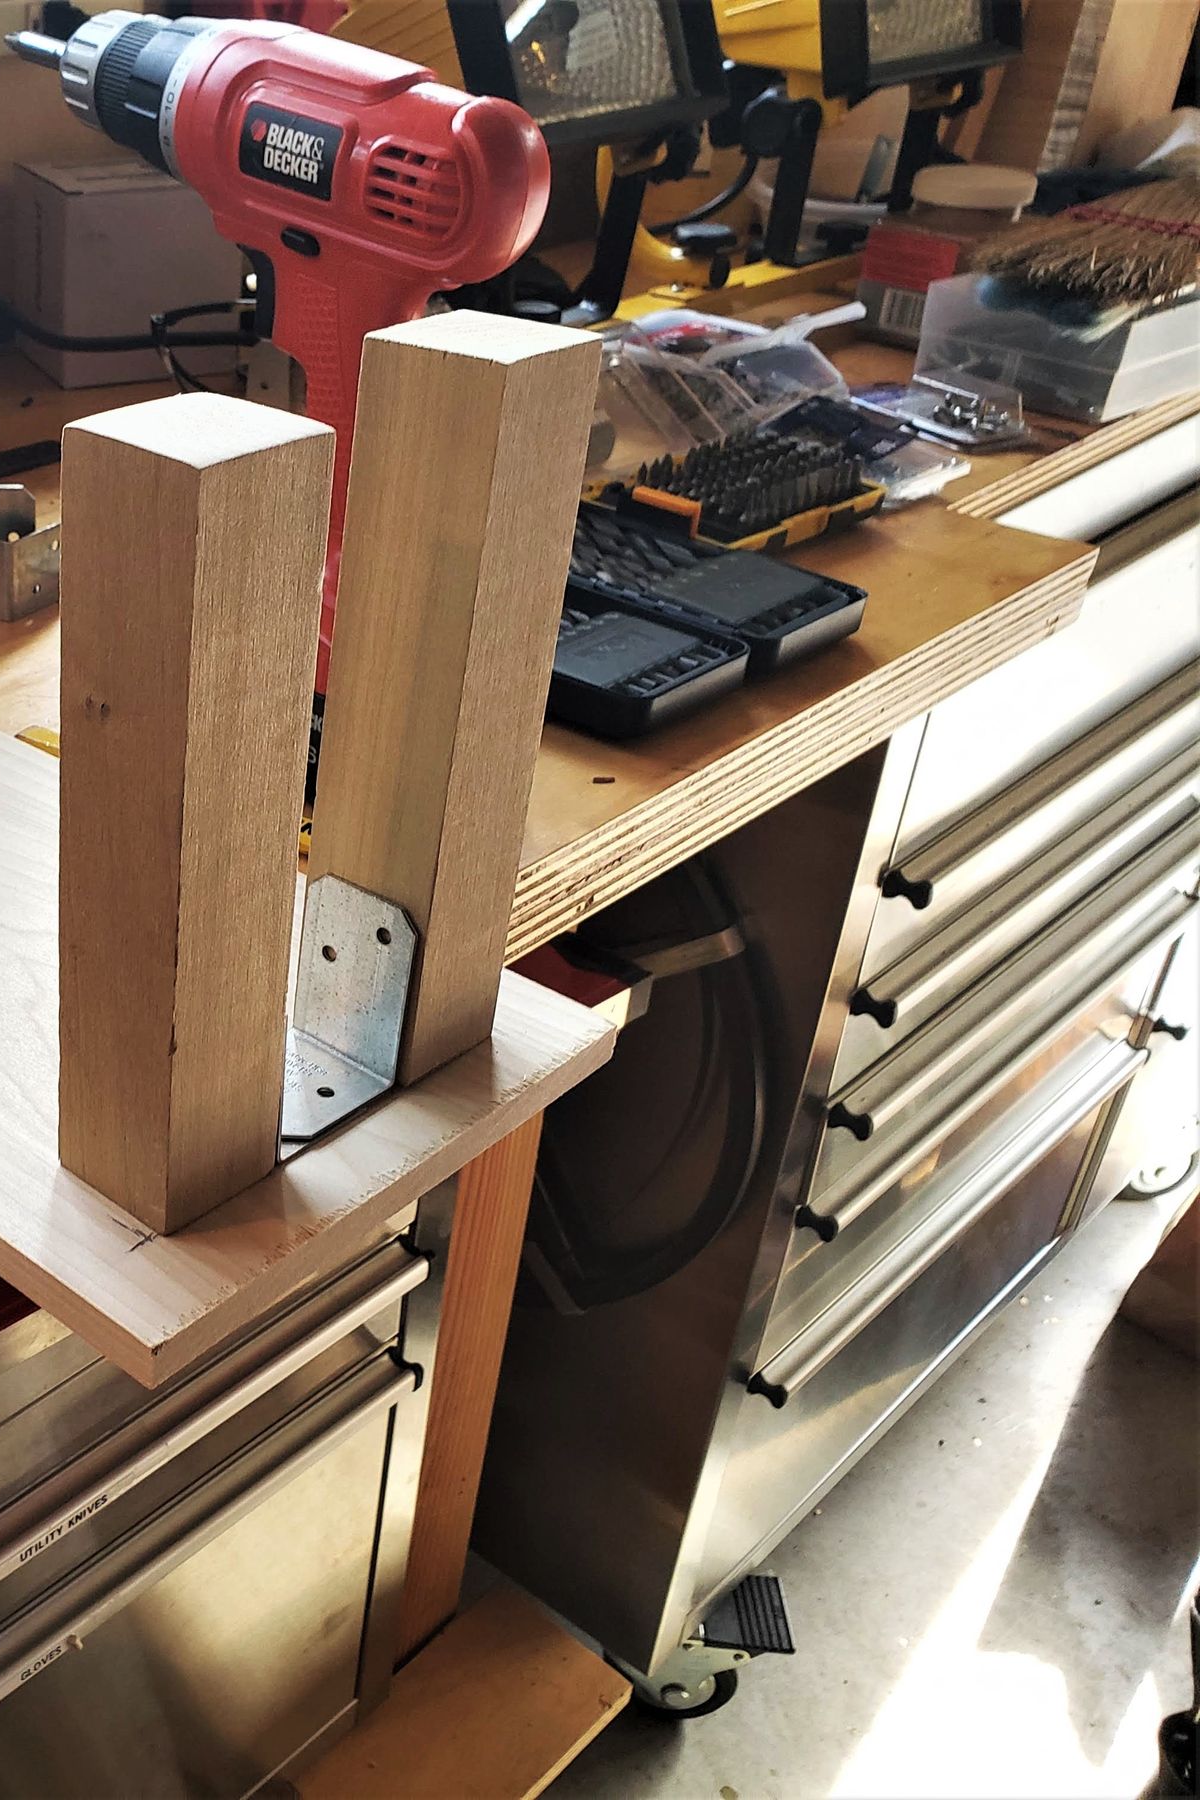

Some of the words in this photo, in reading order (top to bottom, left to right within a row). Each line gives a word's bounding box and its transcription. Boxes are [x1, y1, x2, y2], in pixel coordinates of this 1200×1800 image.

[263, 145, 319, 185] DECKER
[19, 1525, 63, 1562] UTILITY
[67, 1494, 108, 1529] KNIVES
[20, 1646, 62, 1681] GLOVES
